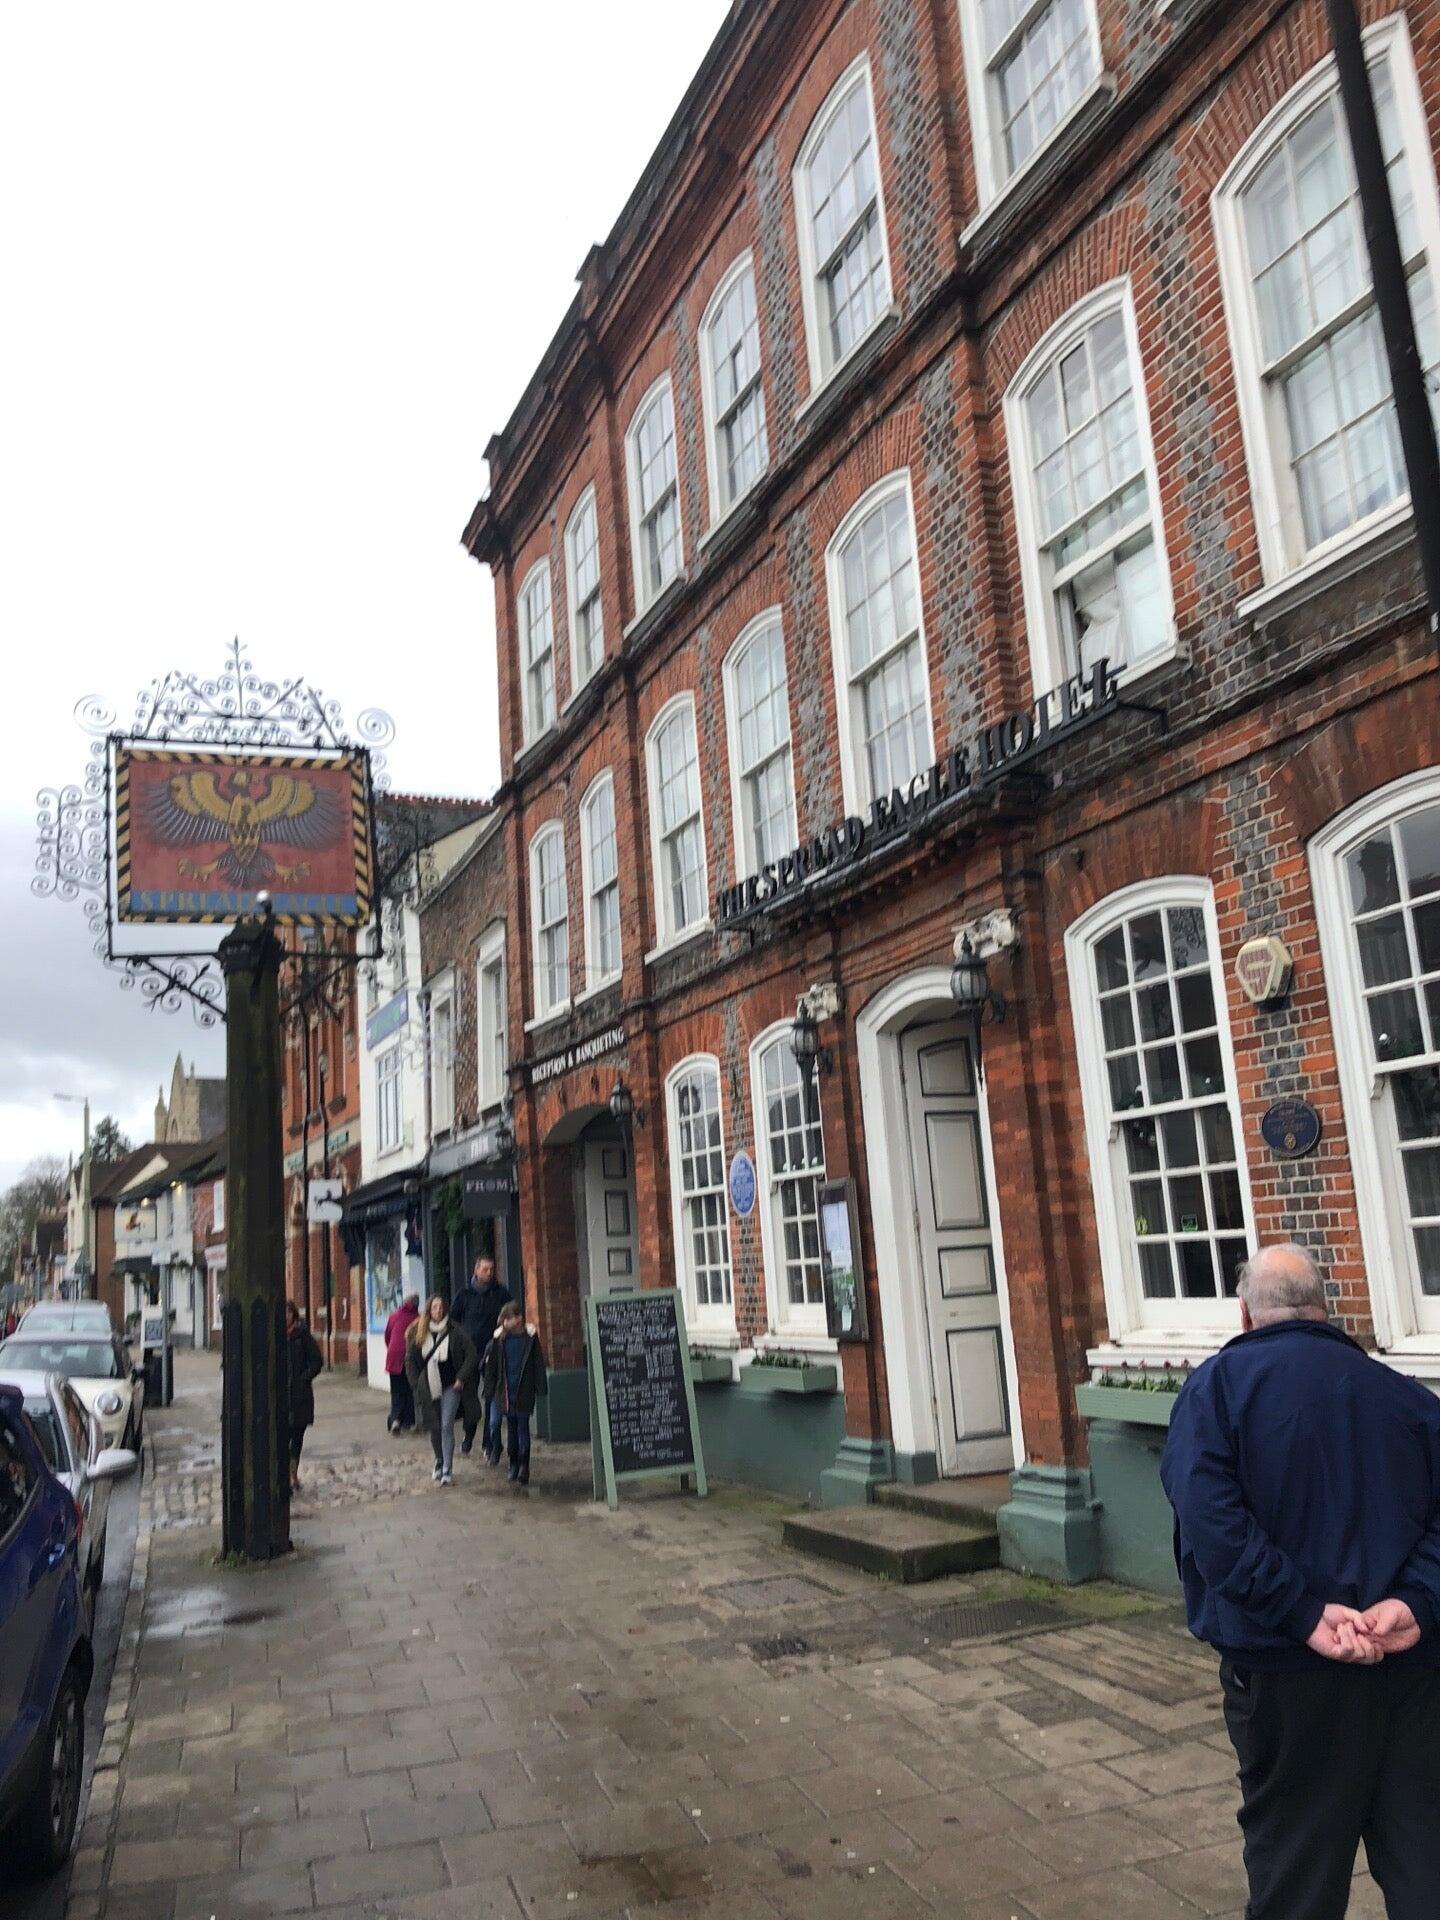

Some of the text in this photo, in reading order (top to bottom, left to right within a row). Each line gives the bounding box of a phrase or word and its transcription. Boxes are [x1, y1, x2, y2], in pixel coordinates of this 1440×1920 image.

[761, 815, 866, 899] SPREAD
[870, 747, 972, 833] EAGLE
[979, 656, 1119, 771] HOTEL
[139, 890, 261, 913] SPREAD
[531, 1054, 567, 1084] RECEPTION
[575, 1026, 624, 1063] BANQUETING
